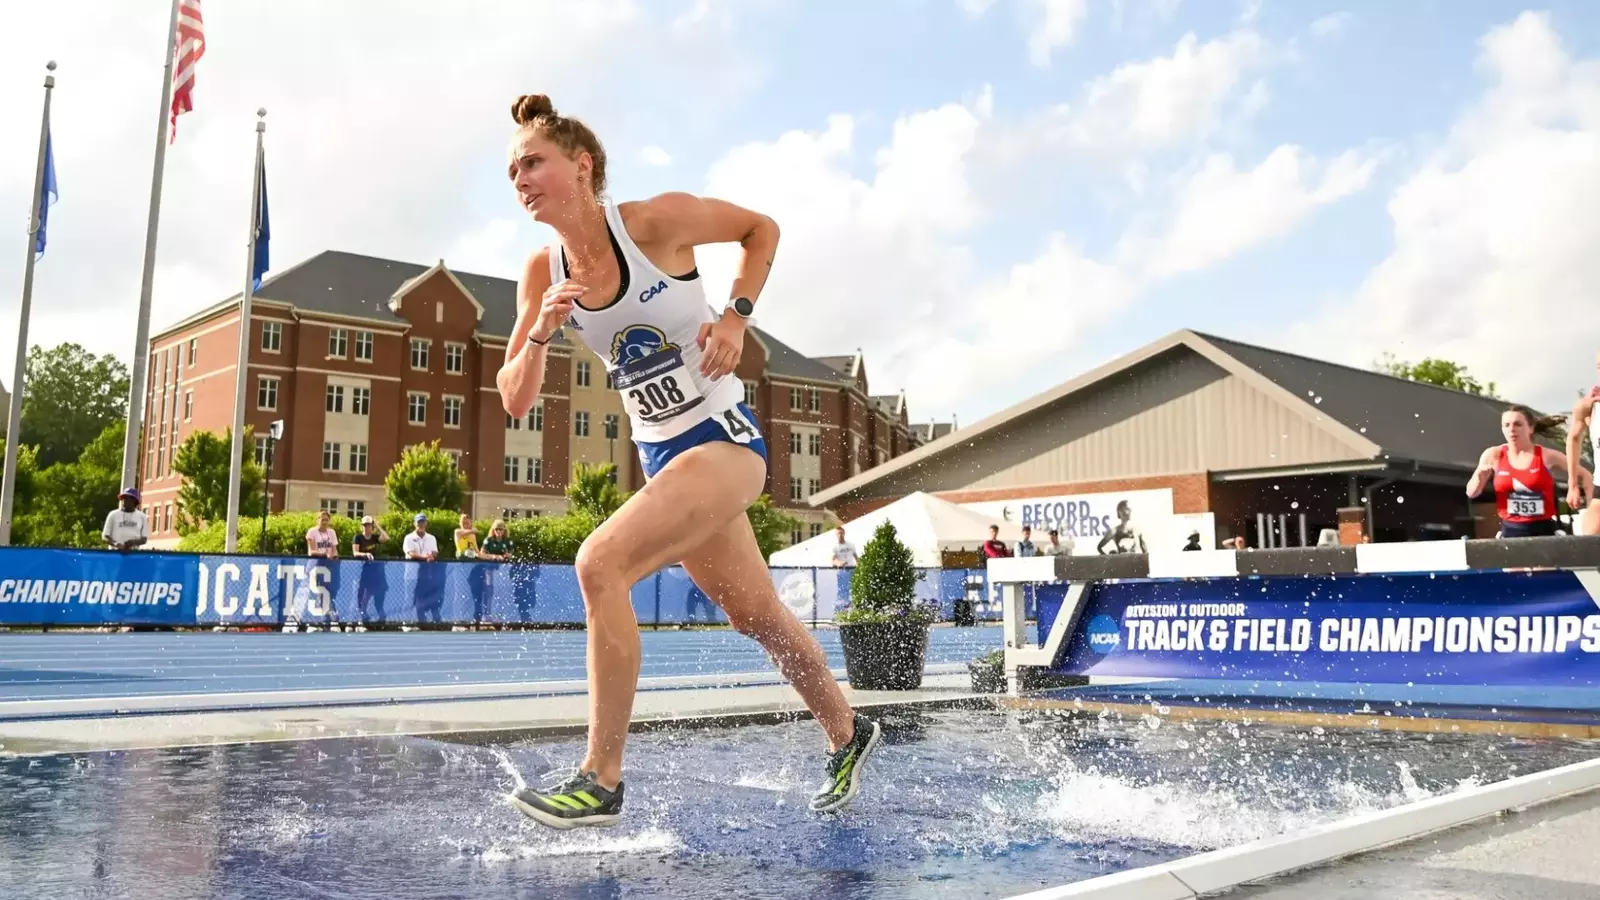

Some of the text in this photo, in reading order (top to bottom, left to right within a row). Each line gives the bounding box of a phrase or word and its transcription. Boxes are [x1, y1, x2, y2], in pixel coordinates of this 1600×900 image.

[639, 280, 668, 303] CAA
[629, 375, 686, 416] 308
[723, 409, 755, 437] 4
[1022, 500, 1091, 522] RECORD
[1512, 501, 1537, 514] 353
[0, 579, 182, 606] CHAMPIONSHIPS
[1126, 603, 1245, 618] DIVISION I OUTDOOR
[1090, 633, 1120, 645] NCAA
[1125, 614, 1600, 653] TRACK & FIELD CHAMPIONSHIPS
